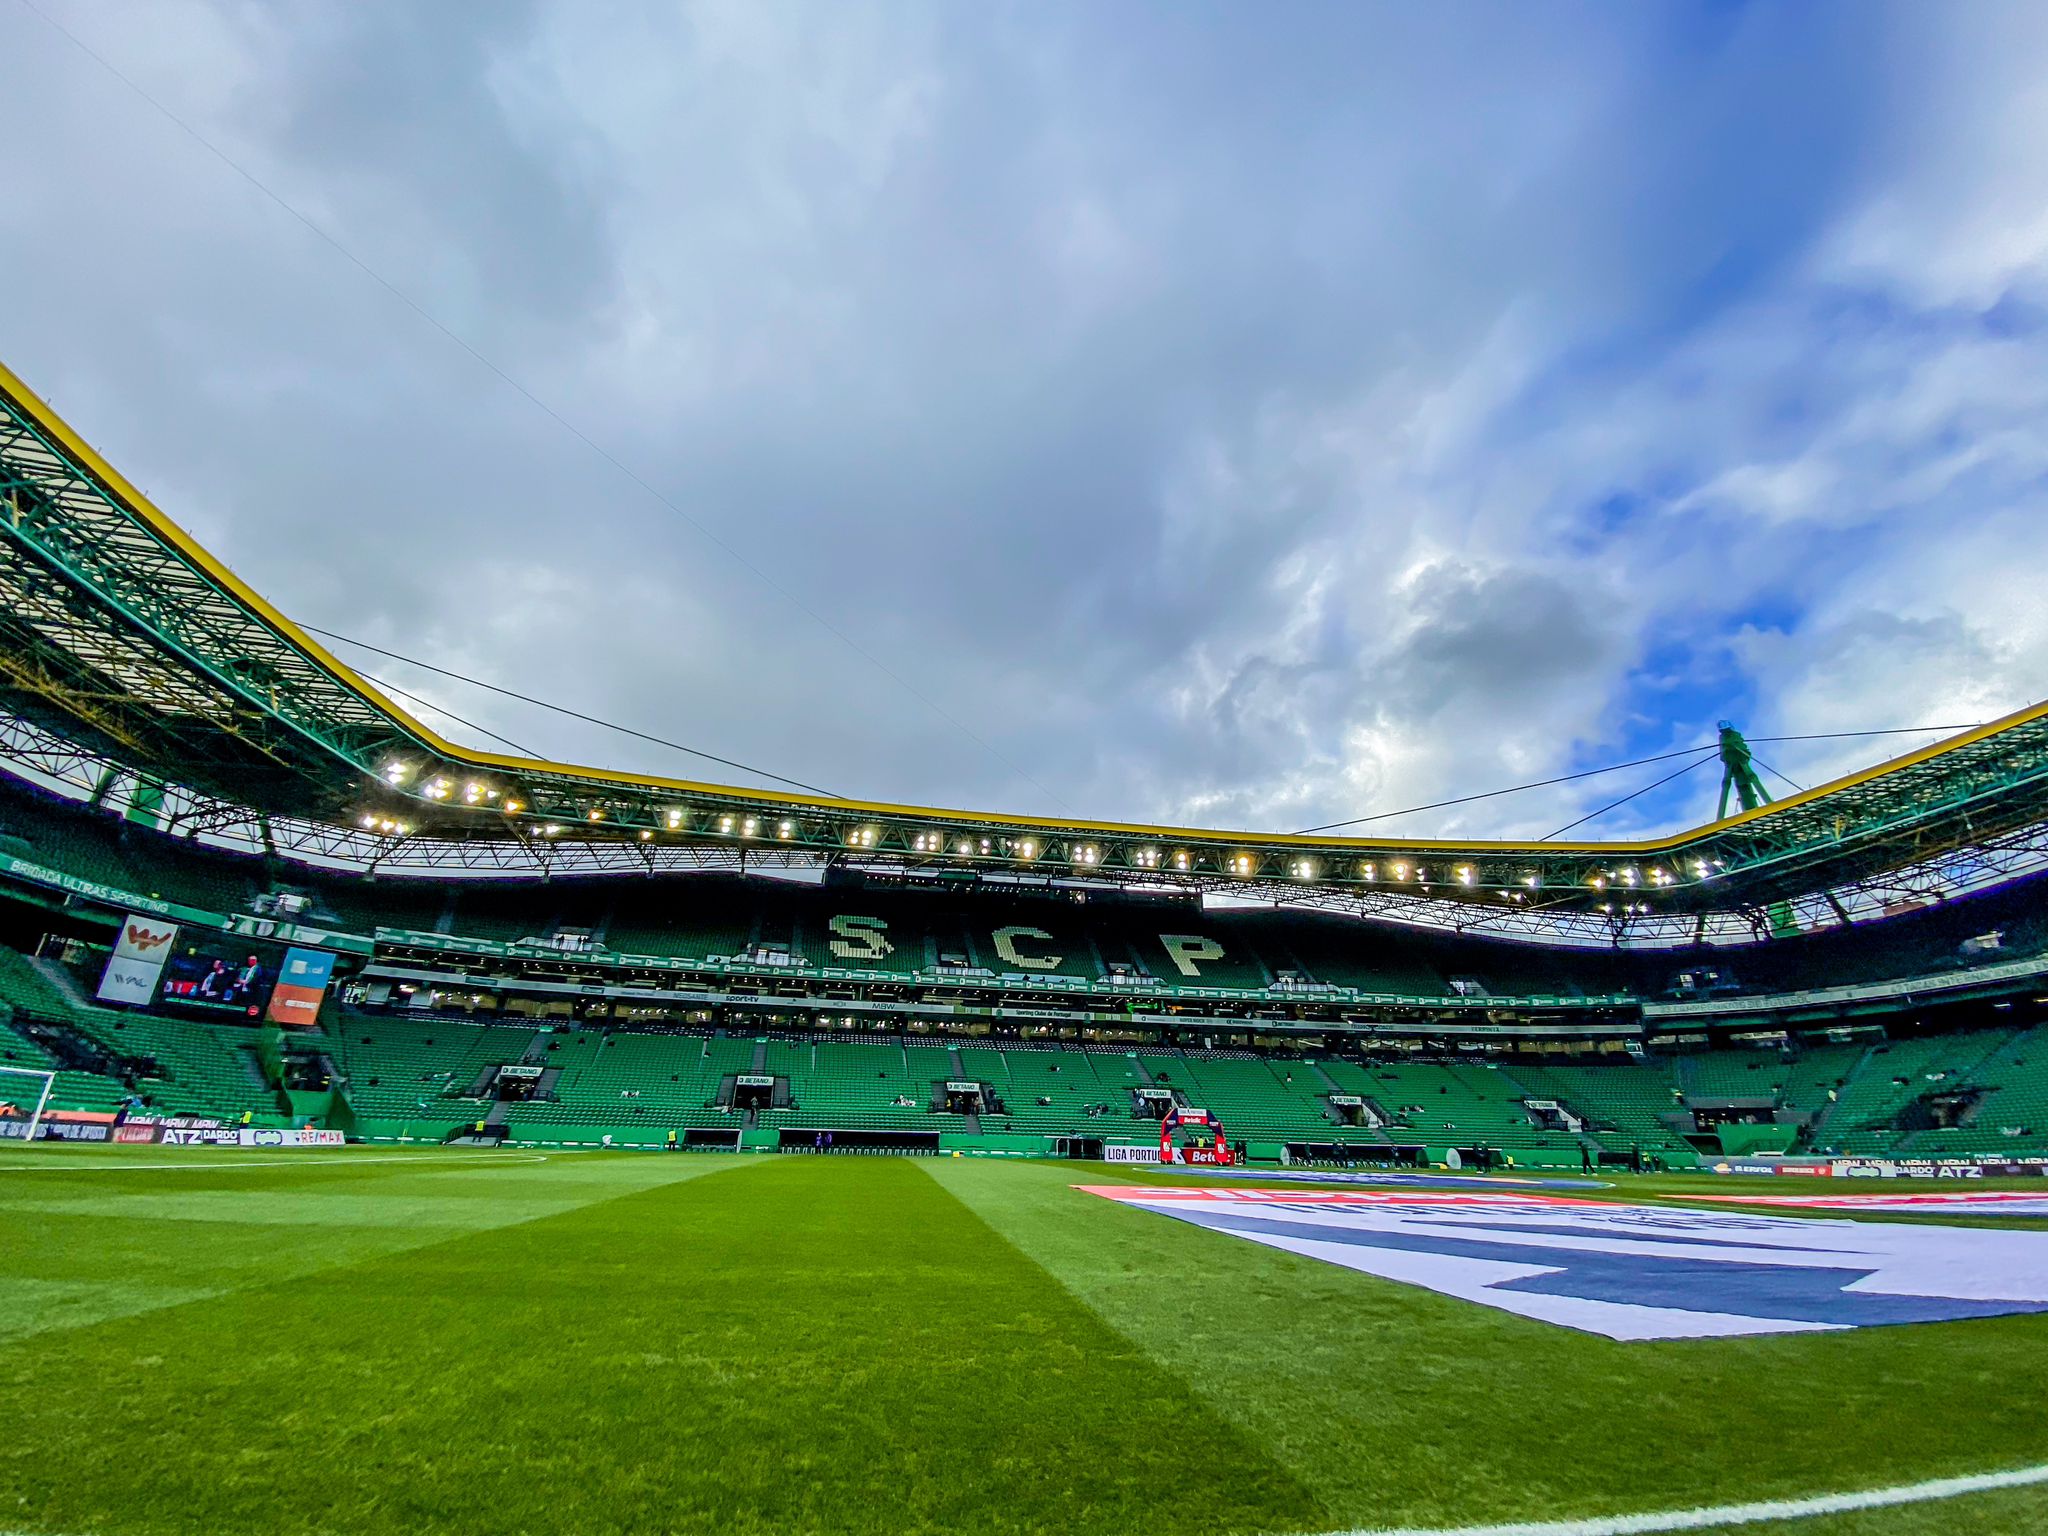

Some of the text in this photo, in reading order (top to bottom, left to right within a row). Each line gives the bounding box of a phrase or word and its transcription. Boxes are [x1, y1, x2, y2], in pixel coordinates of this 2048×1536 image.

[10, 860, 169, 913] BRIGADA ULTRAS SPORTING
[829, 915, 1227, 976] S C P
[509, 1067, 539, 1075] BETANO
[162, 1129, 202, 1145] ATZ
[204, 1130, 237, 1140] DARDO
[302, 1132, 342, 1143] RE/MAX
[1108, 1149, 1161, 1161] LIGA PORTU
[1896, 1166, 1934, 1174] DARDO
[1937, 1166, 1982, 1178] ATZ
[1131, 1187, 1549, 1203] Betclic
